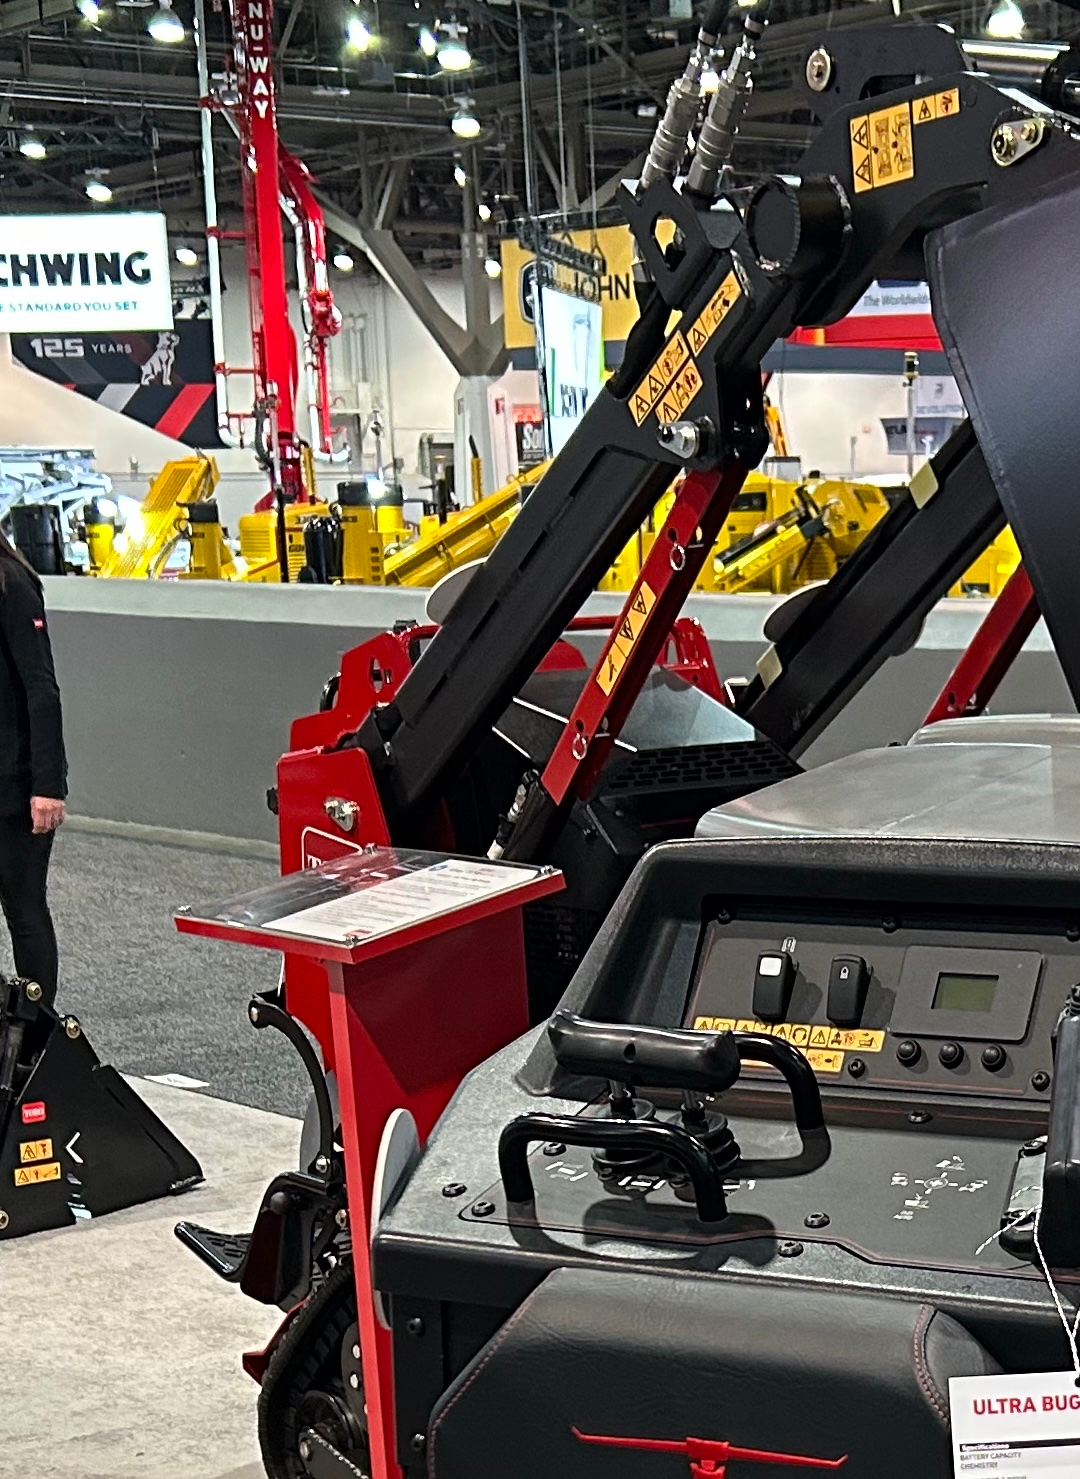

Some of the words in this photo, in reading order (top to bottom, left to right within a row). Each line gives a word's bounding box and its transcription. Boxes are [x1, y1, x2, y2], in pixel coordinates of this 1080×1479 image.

[248, 2, 269, 119] NU-WAY
[9, 302, 81, 312] STANDARD
[85, 302, 112, 311] YOU
[30, 338, 84, 358] 125
[91, 343, 132, 354] YEARS
[973, 1396, 1036, 1415] ULTRA
[990, 1451, 1021, 1459] CAPACITY
